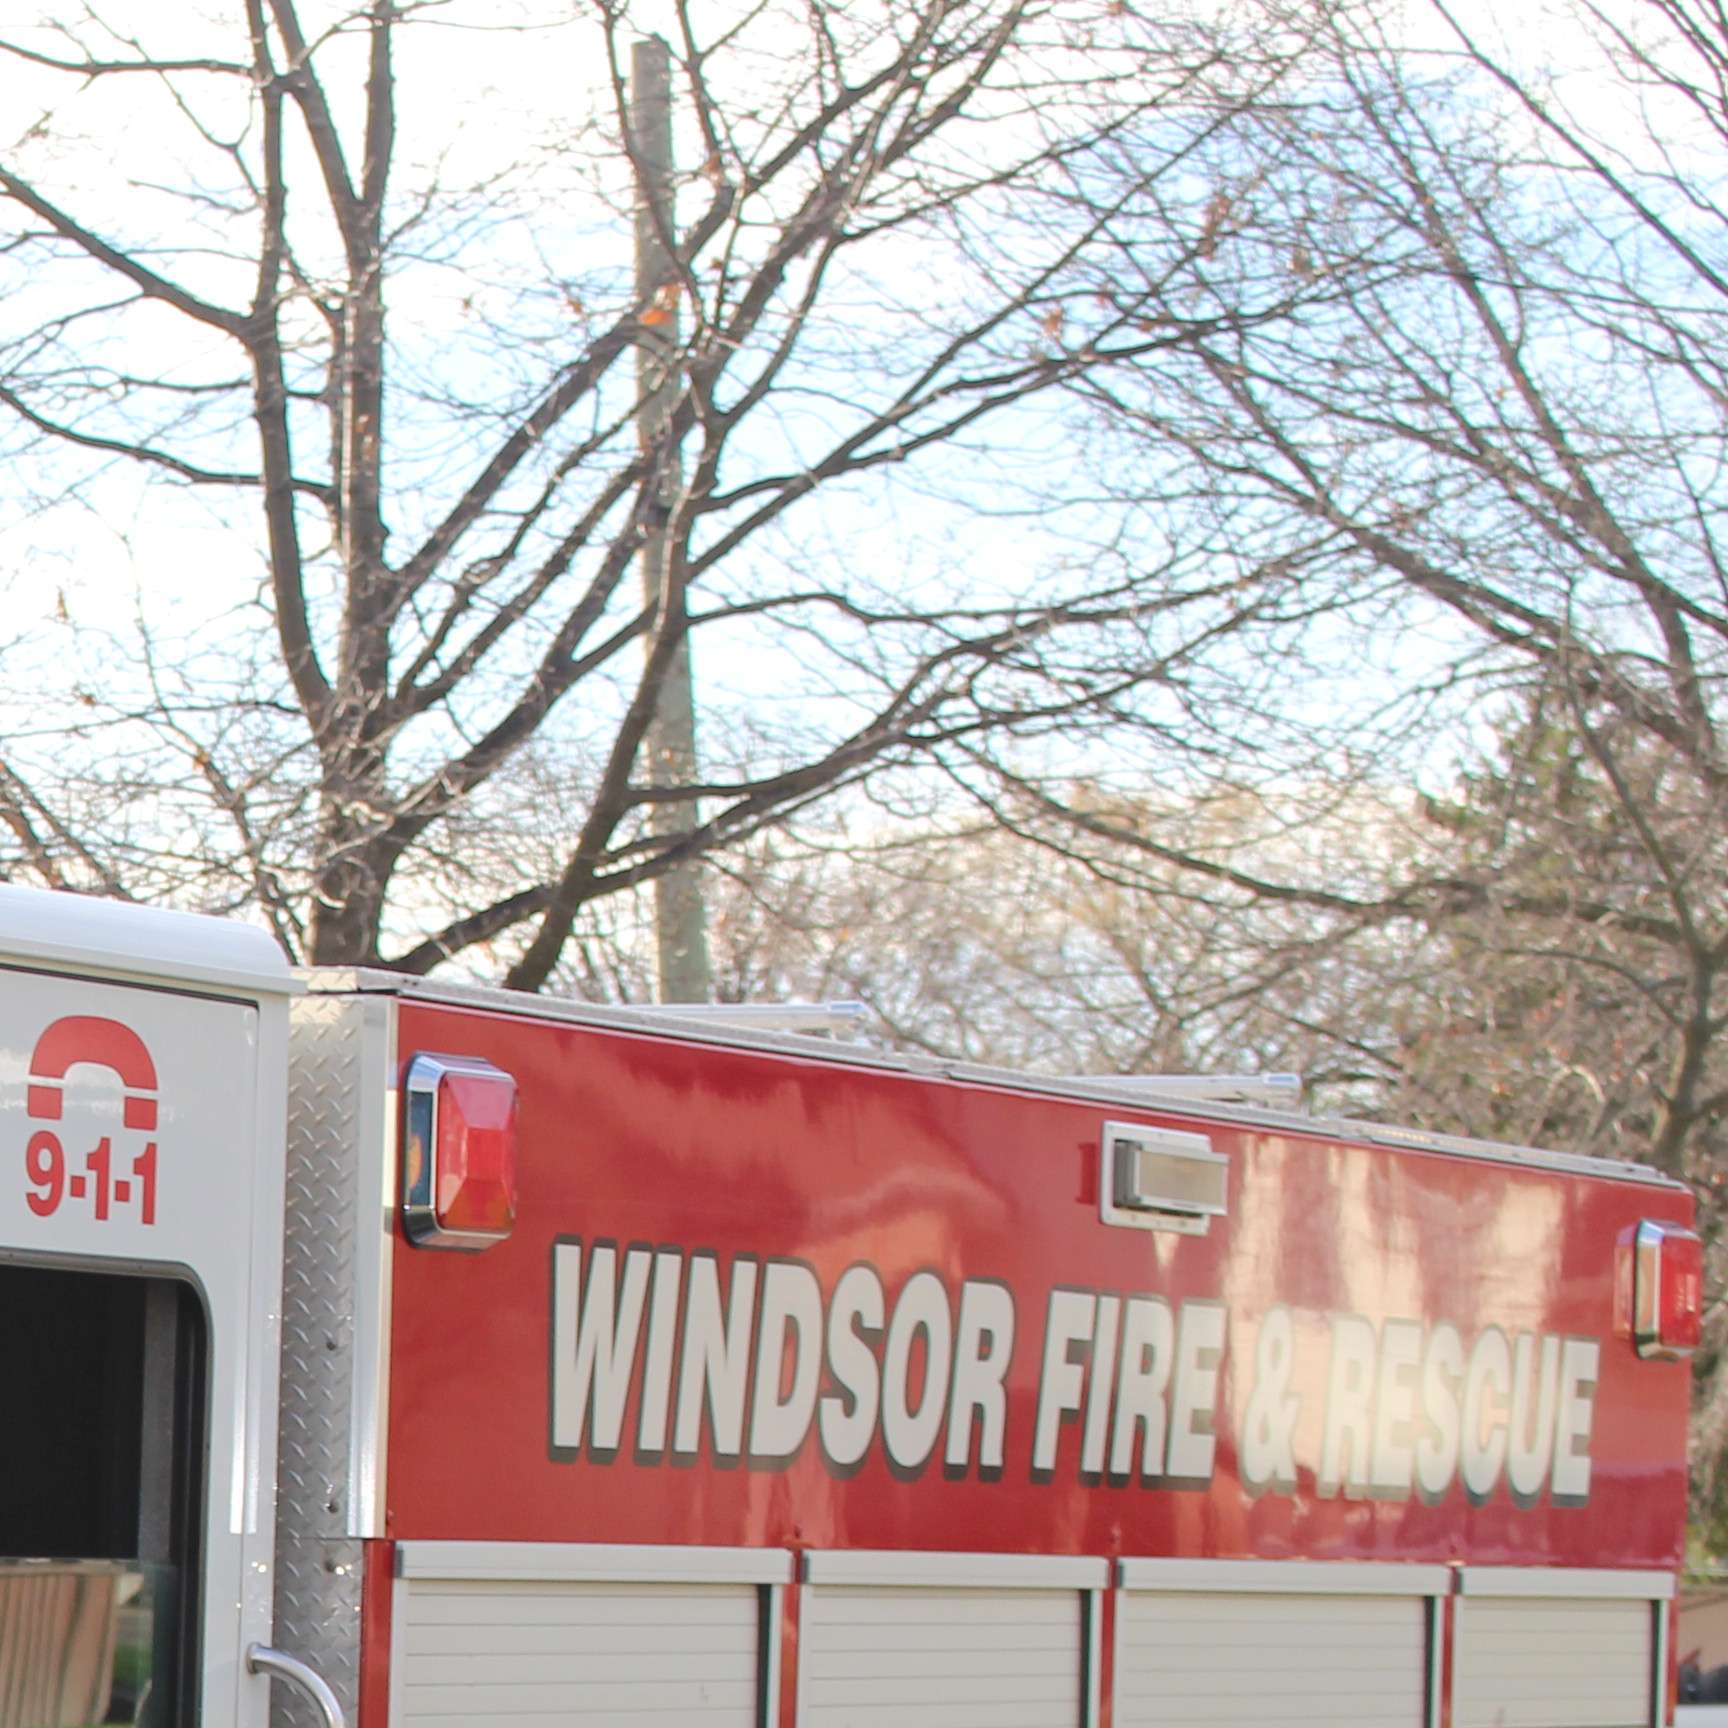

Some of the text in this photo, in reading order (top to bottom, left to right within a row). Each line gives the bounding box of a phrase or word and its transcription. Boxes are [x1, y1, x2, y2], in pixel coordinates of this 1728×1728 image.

[25, 1130, 157, 1227] 9-1-1
[549, 1236, 1602, 1510] WINDSOR FIRE & RESCUE
